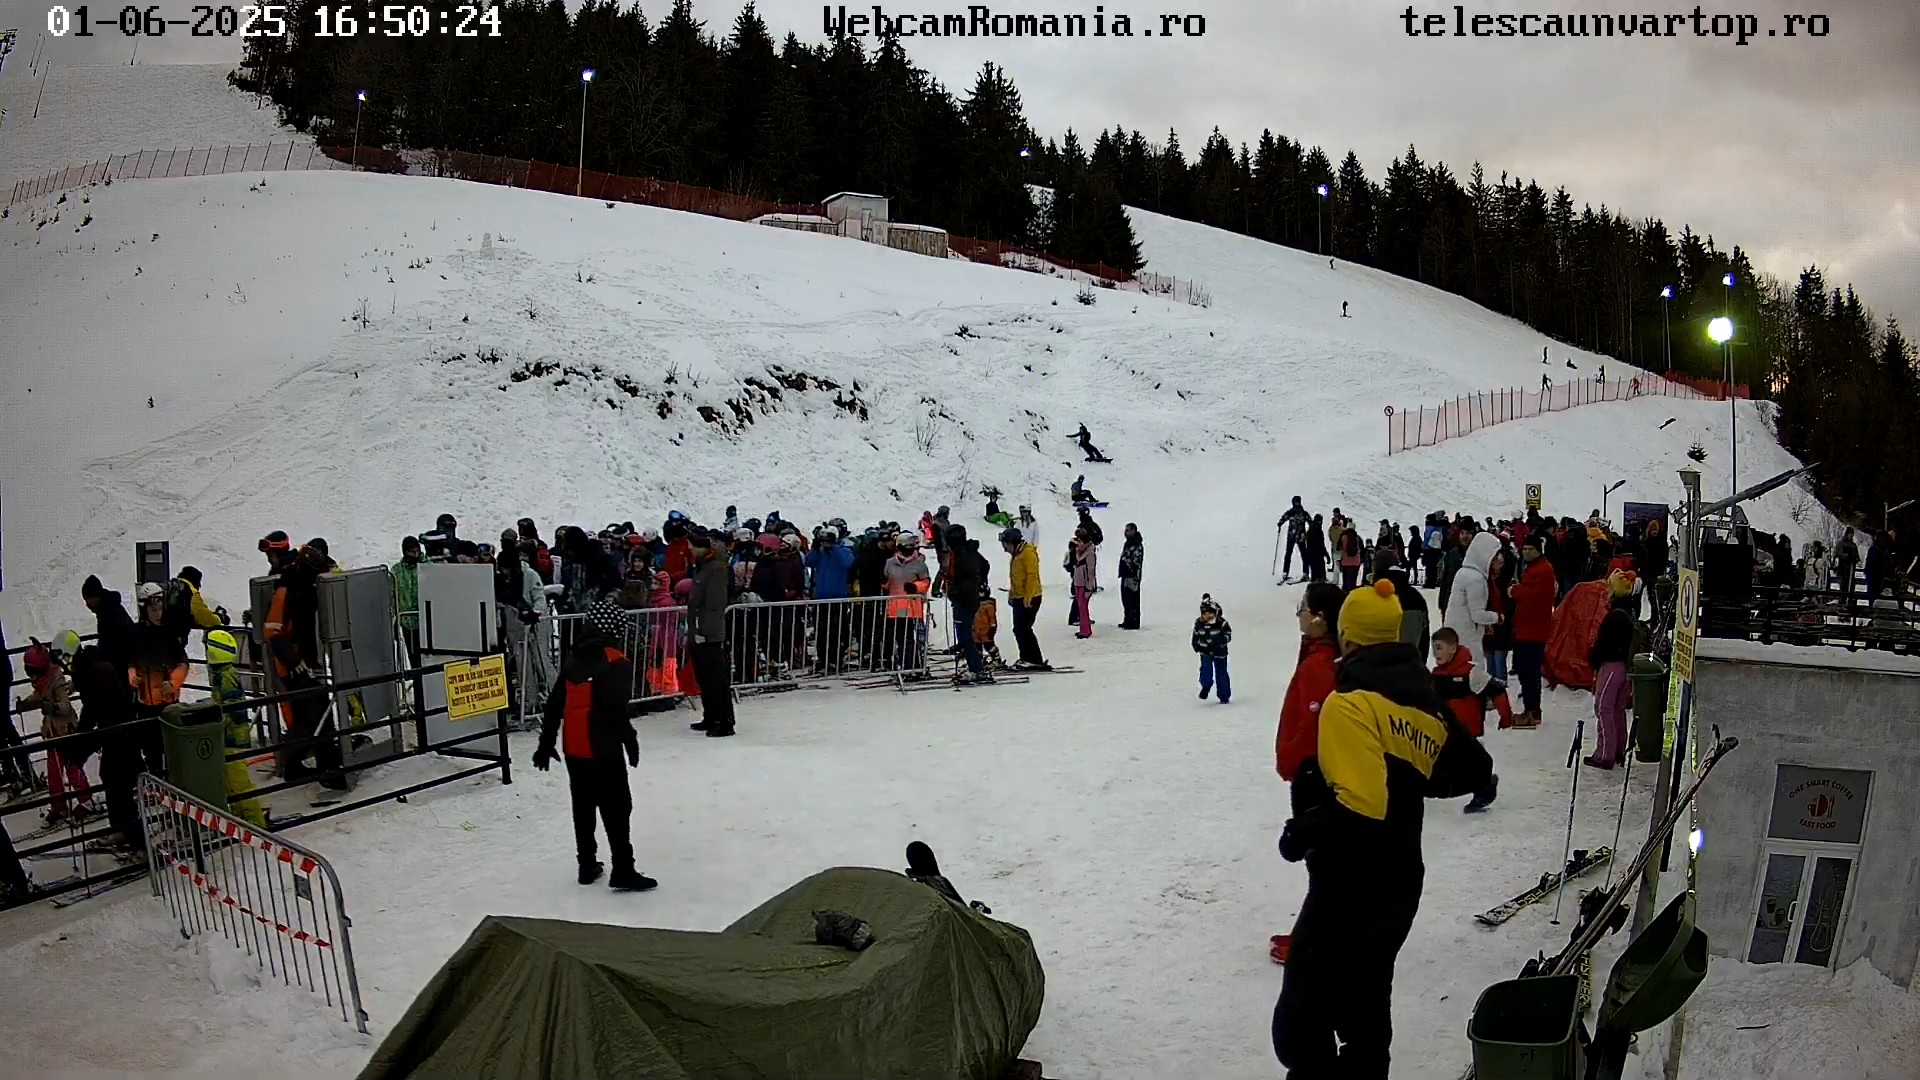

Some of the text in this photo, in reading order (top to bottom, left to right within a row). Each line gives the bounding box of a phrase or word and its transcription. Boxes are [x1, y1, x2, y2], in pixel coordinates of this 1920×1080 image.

[1789, 779, 1854, 800] ONE SMART COFFEE
[1799, 818, 1836, 829] FAST FOOD
